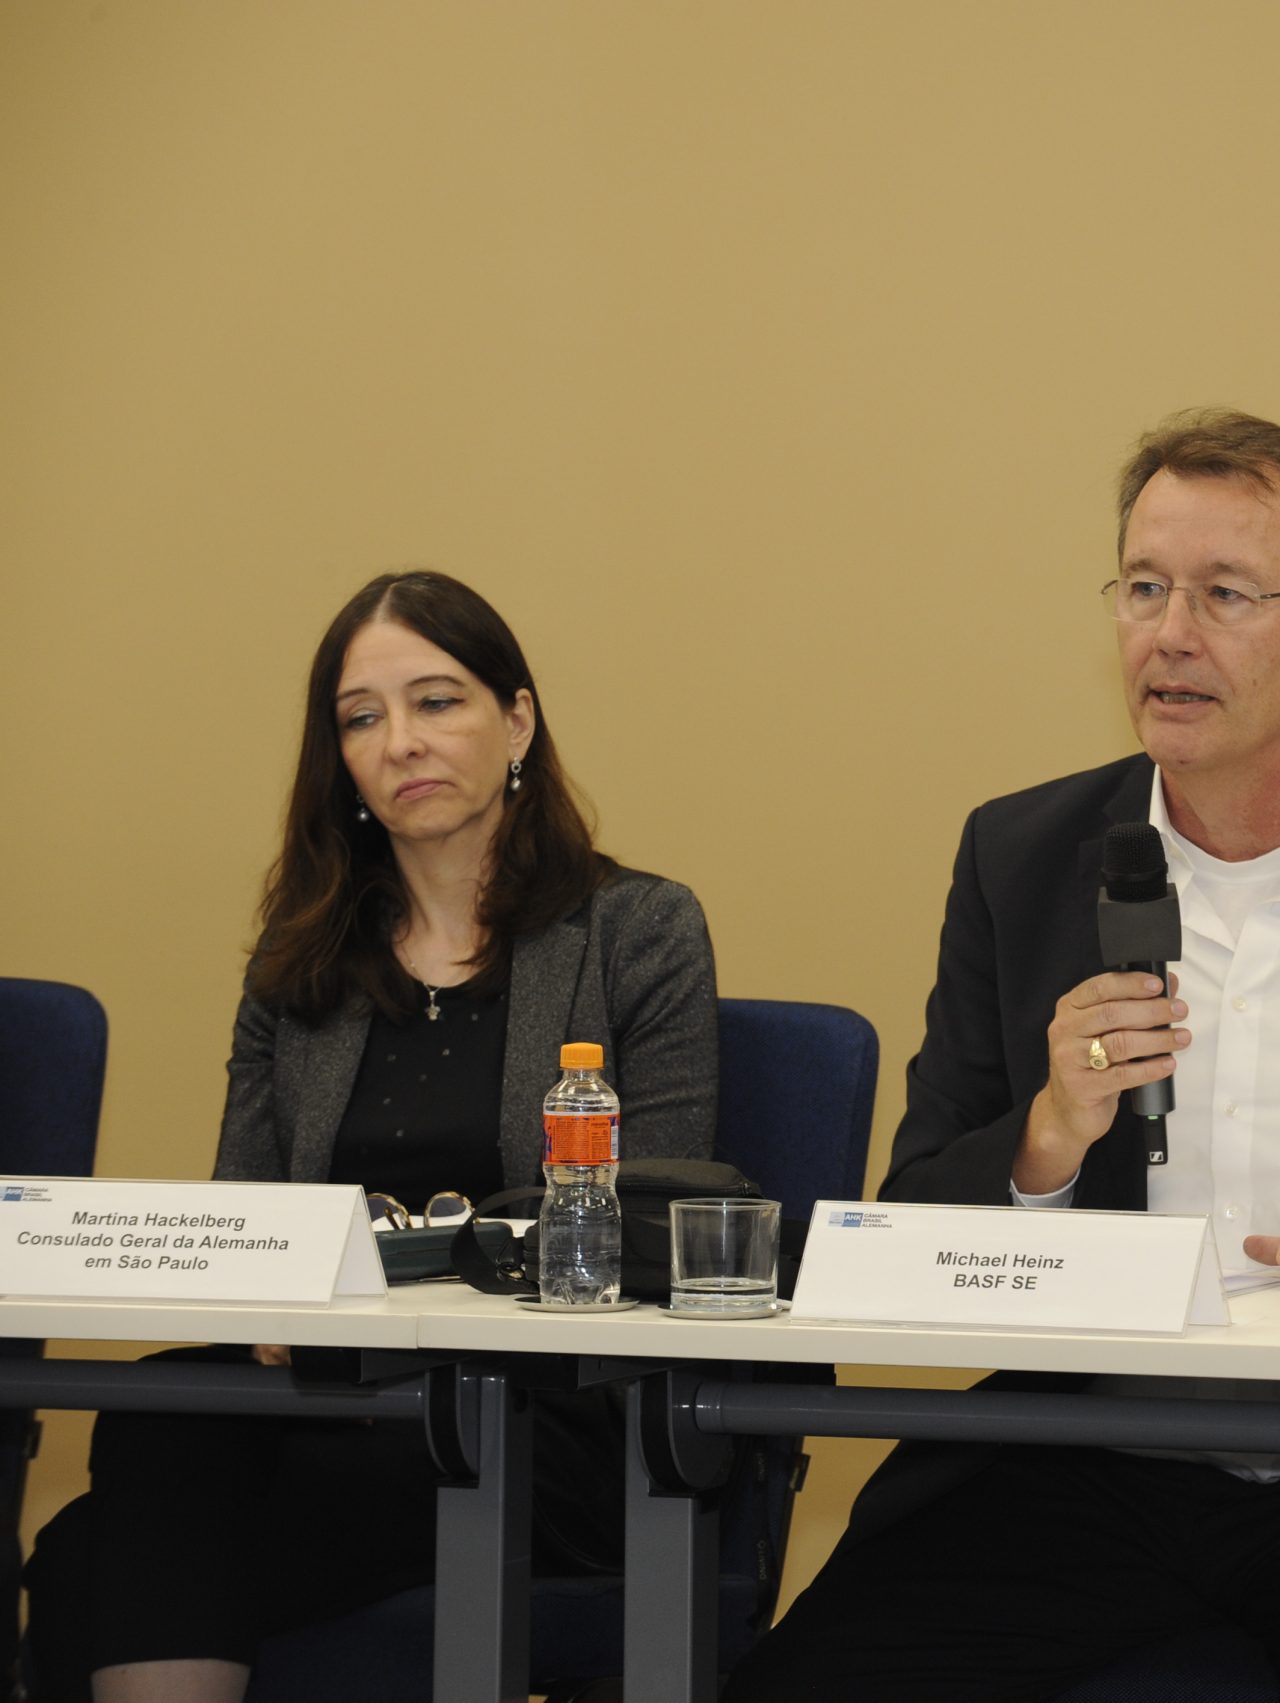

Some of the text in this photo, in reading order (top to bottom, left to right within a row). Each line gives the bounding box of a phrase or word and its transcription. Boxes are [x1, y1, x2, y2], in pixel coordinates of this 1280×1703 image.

[72, 1211, 246, 1232] Martina Hackelberg
[17, 1231, 289, 1250] Consulado Geral da Alemanha
[85, 1255, 209, 1270] em São Paulo
[936, 1251, 1065, 1269] Michael Heinz
[953, 1273, 1038, 1290] BASF SE
